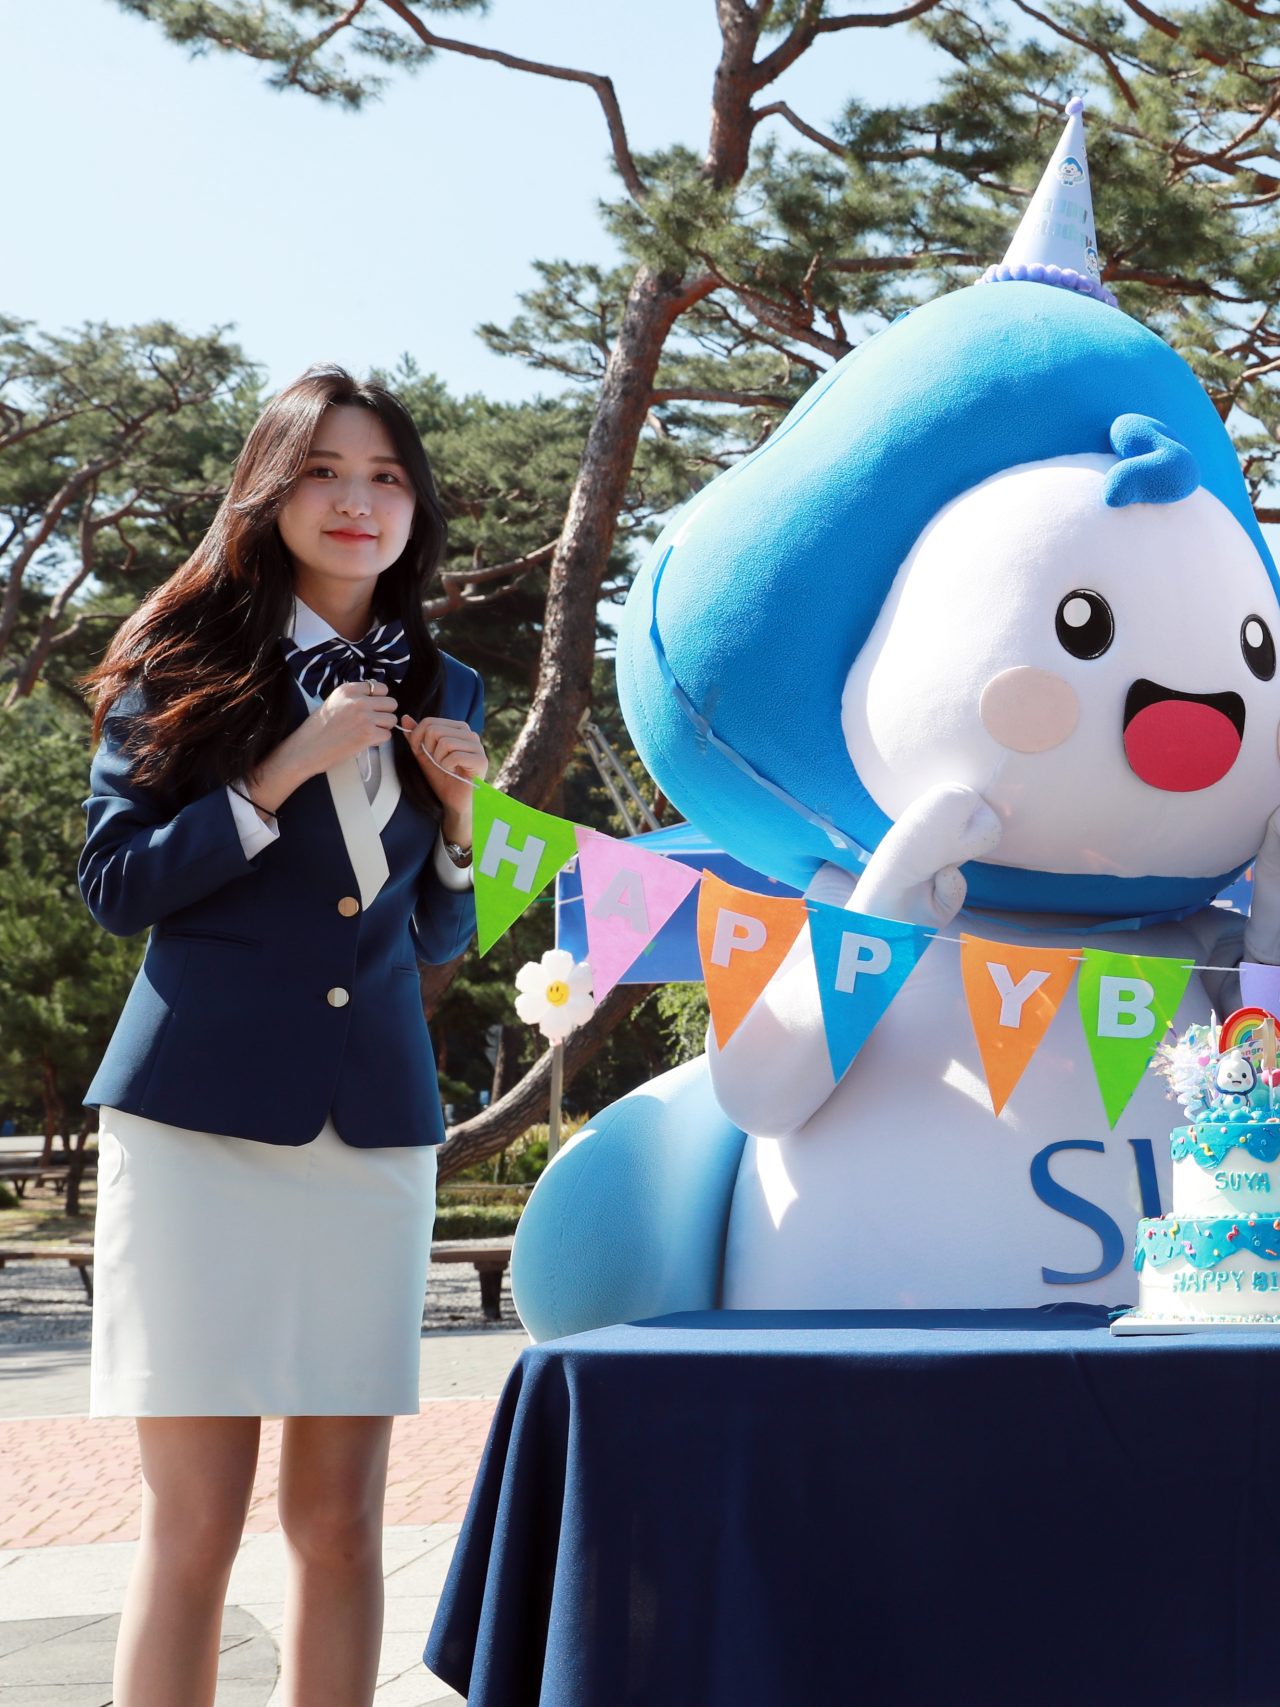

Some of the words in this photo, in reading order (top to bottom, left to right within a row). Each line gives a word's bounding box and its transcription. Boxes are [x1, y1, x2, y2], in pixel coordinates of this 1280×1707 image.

[478, 818, 1052, 1029] HAPPY
[1215, 1171, 1271, 1193] SUYA
[1173, 1270, 1244, 1293] HAPPY
